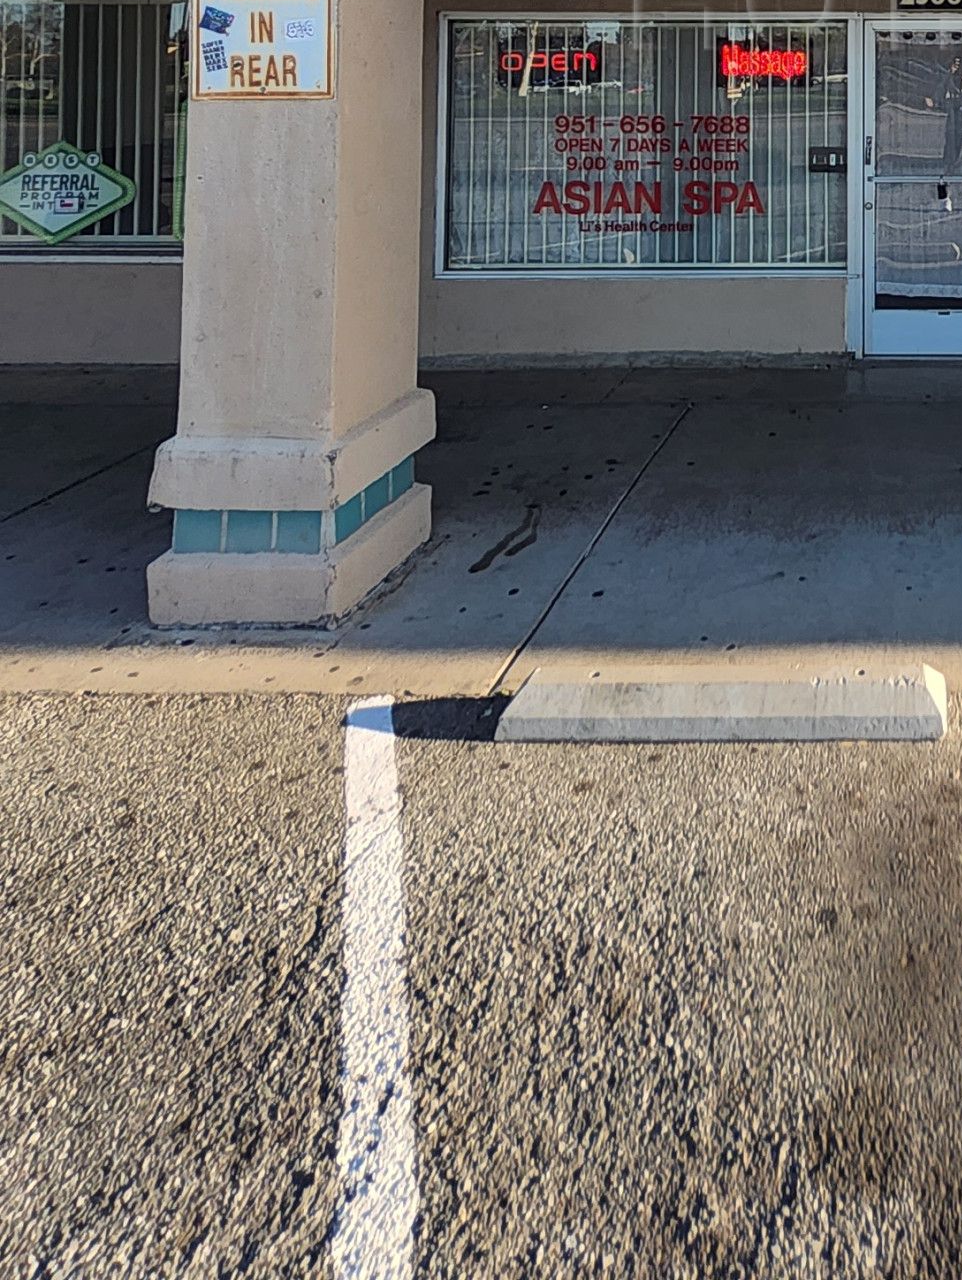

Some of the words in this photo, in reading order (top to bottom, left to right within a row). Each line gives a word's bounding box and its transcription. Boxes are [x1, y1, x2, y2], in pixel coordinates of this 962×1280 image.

[250, 11, 274, 43] IN
[230, 54, 297, 87] REAR
[554, 138, 604, 152] OPEN
[609, 138, 621, 152] 7
[627, 138, 671, 152] DAYS
[678, 138, 691, 152] A
[698, 138, 748, 152] WEEK
[26, 154, 98, 166] BEST
[566, 156, 606, 171] 9.00
[614, 159, 640, 171] am
[21, 174, 99, 191] REFERRAL
[20, 191, 99, 201] PROGRAM
[532, 181, 662, 215] ASIAN
[683, 180, 766, 215] SPA
[32, 201, 45, 210] IN
[604, 220, 647, 232] Health
[650, 220, 695, 232] Center
